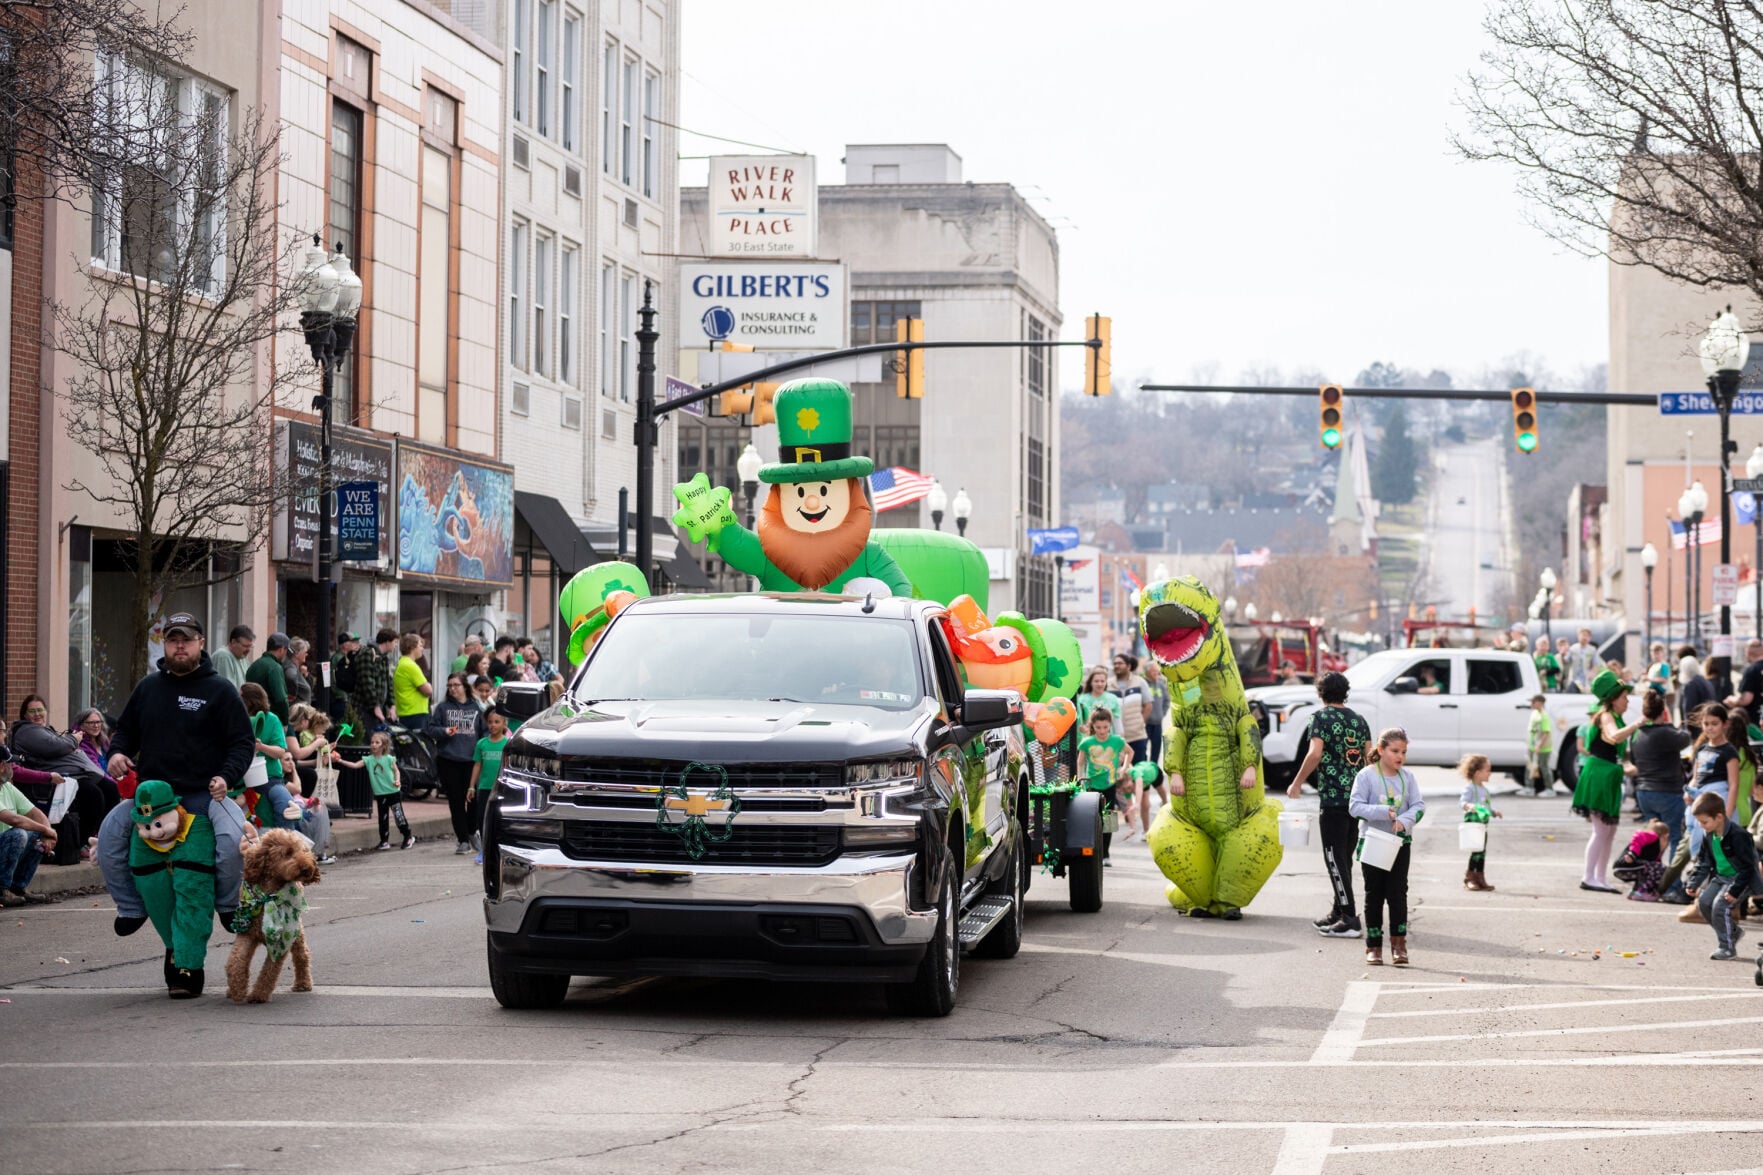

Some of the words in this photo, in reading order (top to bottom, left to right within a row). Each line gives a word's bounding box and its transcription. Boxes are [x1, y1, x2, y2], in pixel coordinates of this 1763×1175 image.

[728, 166, 795, 185] RIVER
[730, 185, 793, 202] WALK
[729, 218, 795, 235] PLACE
[728, 242, 742, 252] 30
[744, 242, 765, 252] East
[767, 242, 794, 252] State
[692, 274, 830, 298] GILBERT'S
[741, 312, 807, 322] INSURANCE
[809, 312, 818, 322] &
[741, 325, 815, 335] CONSULTING
[1677, 394, 1763, 413] Shengo
[345, 490, 371, 502] WE
[685, 486, 707, 500] Happy
[342, 503, 374, 516] ARE
[699, 498, 725, 523] Patrick's
[342, 517, 375, 527] PENN
[341, 528, 376, 539] STATE
